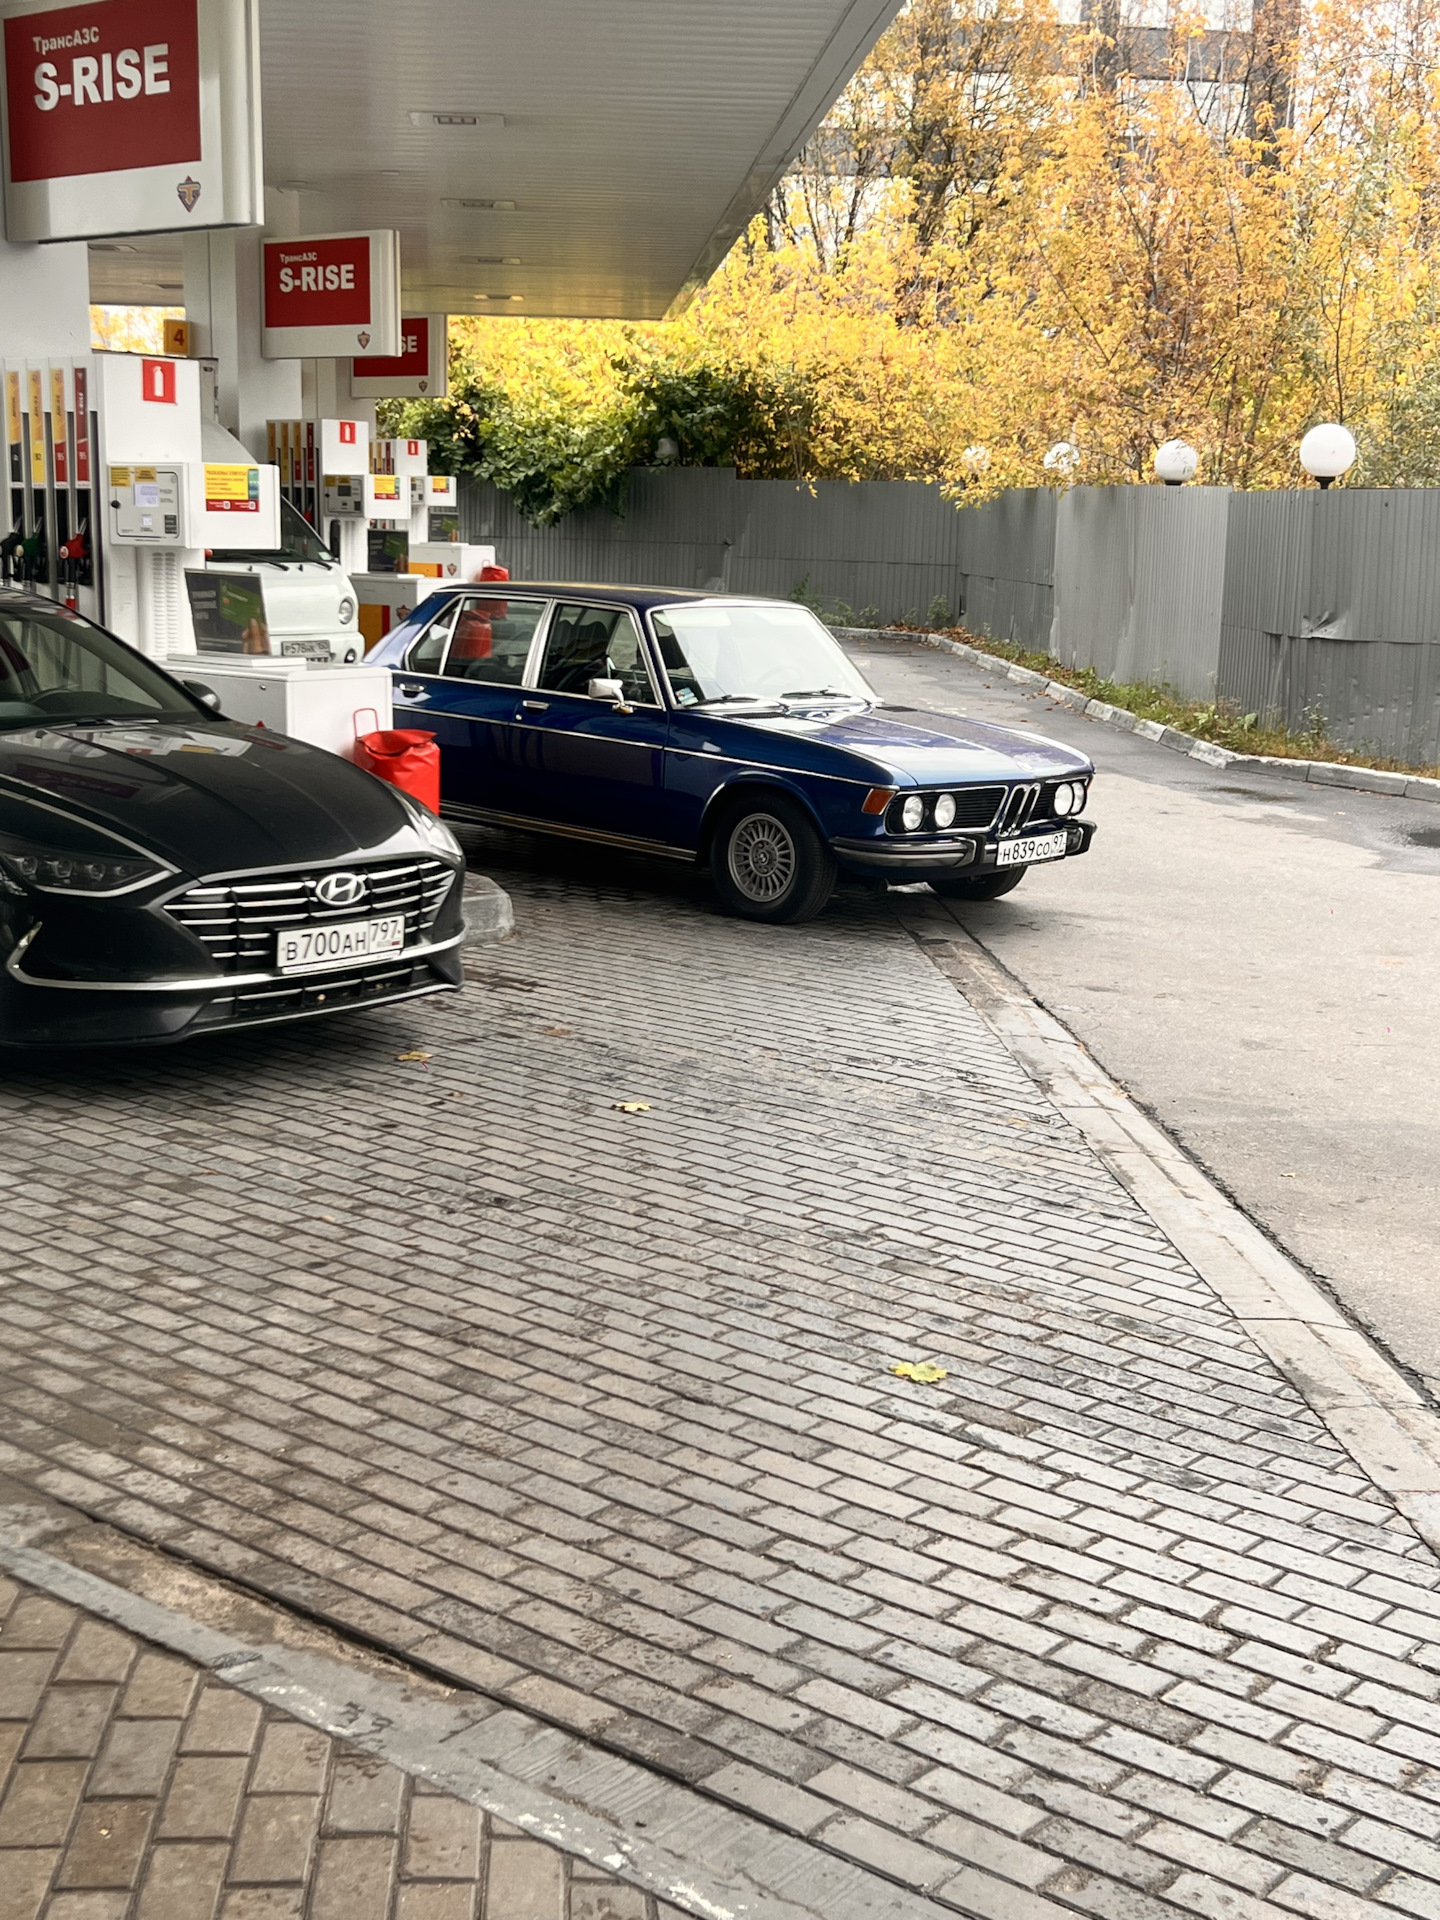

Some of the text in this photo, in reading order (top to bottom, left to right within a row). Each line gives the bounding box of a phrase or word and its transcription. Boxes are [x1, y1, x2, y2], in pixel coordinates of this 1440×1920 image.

[32, 26, 100, 55] ТрансАЗС
[34, 43, 171, 111] S-RISE
[279, 252, 318, 264] ТрансАЗС
[279, 264, 355, 293] S-RISE
[173, 329, 185, 346] 4
[1003, 834, 1065, 862] Н839СО 97
[286, 920, 399, 960] В700АН 797
